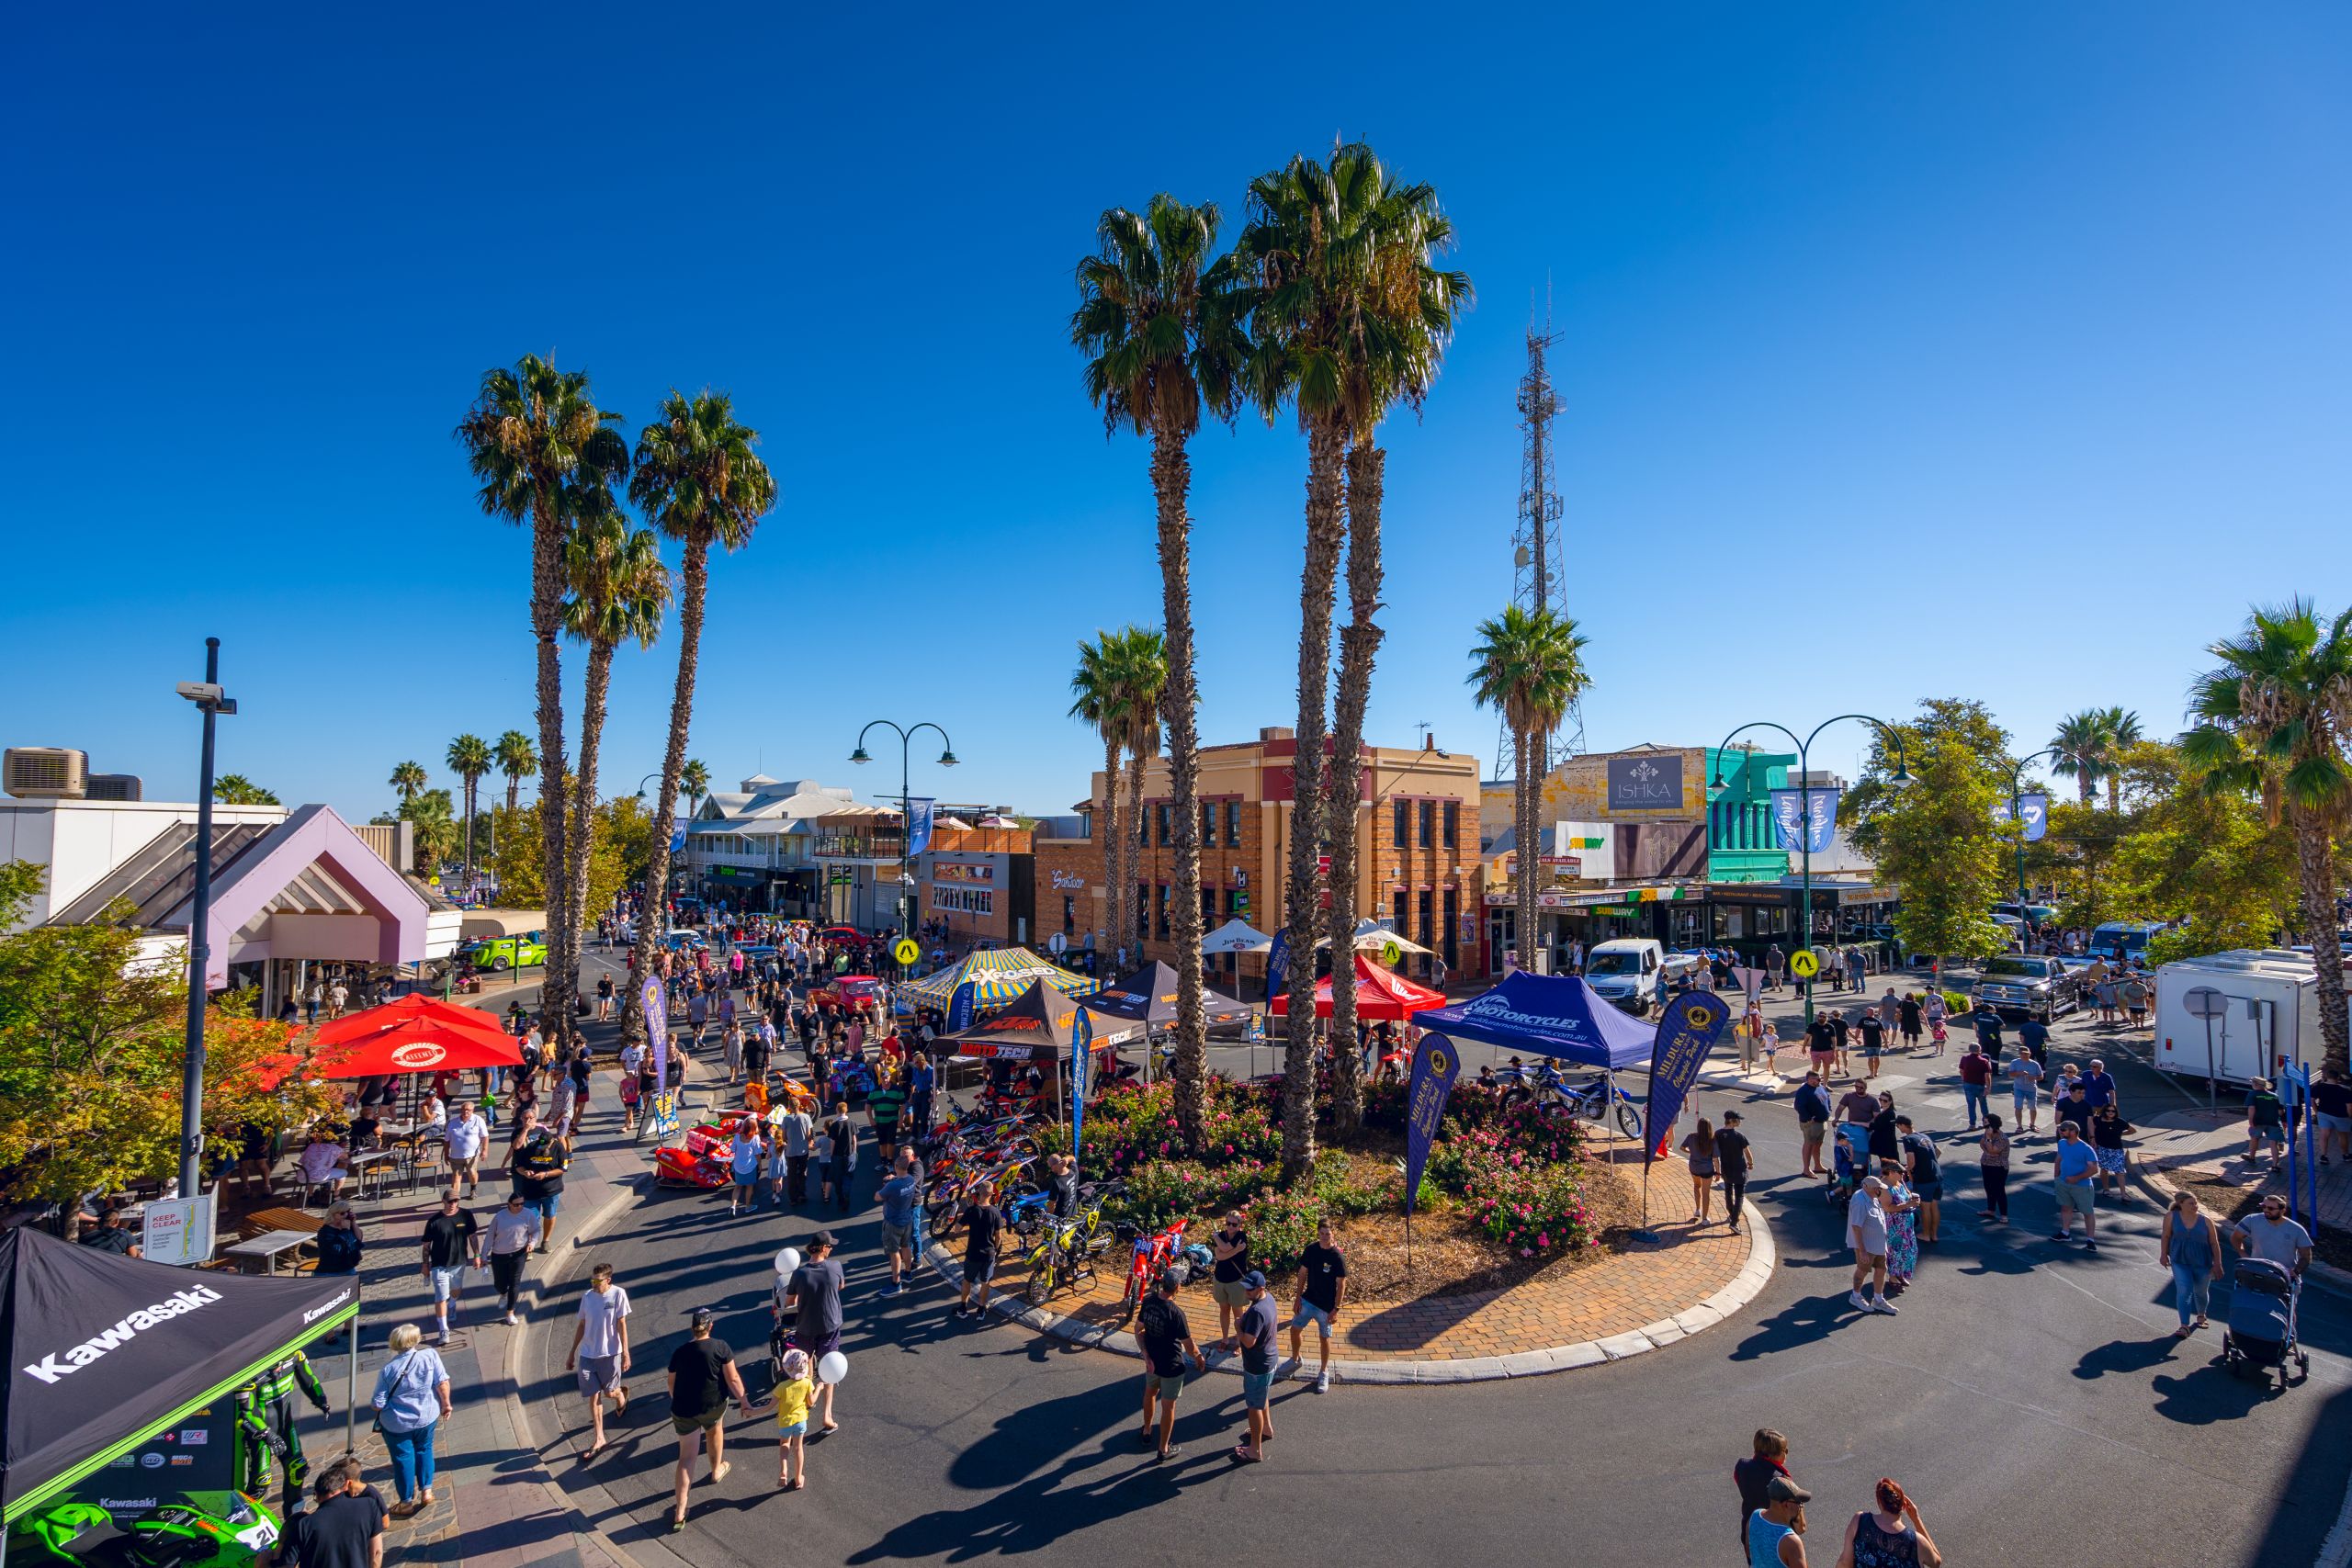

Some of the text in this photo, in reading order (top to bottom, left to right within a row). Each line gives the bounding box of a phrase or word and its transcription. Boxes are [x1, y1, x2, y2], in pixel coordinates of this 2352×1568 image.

[1618, 784, 1671, 799] ISHKA
[1569, 837, 1605, 850] SUBWAY
[1053, 871, 1084, 889] Sandbar
[1596, 907, 1634, 916] SUBWAY
[968, 967, 1057, 987] EXPOSED
[1103, 990, 1148, 1004] MOTOTECH
[1474, 1006, 1580, 1029] MOTORCYCLES
[1444, 1011, 1588, 1042] www.milduramotorcycles.com.au
[960, 1042, 1033, 1059] MOTOTECH
[1657, 1032, 1687, 1078] MILDURA
[1673, 1059, 1691, 1089] Olympic
[1686, 1038, 1700, 1059] Park
[1410, 1076, 1431, 1124] MILDURA
[153, 1213, 176, 1222] KEEP
[153, 1219, 182, 1229] CLEAR
[1090, 1213, 1098, 1227] 48
[1136, 1239, 1152, 1251] 390
[303, 1288, 351, 1325] Kawasaki
[22, 1284, 223, 1384] Kawasaki
[100, 1497, 157, 1507] Kawasaki
[256, 1526, 275, 1546] 21
